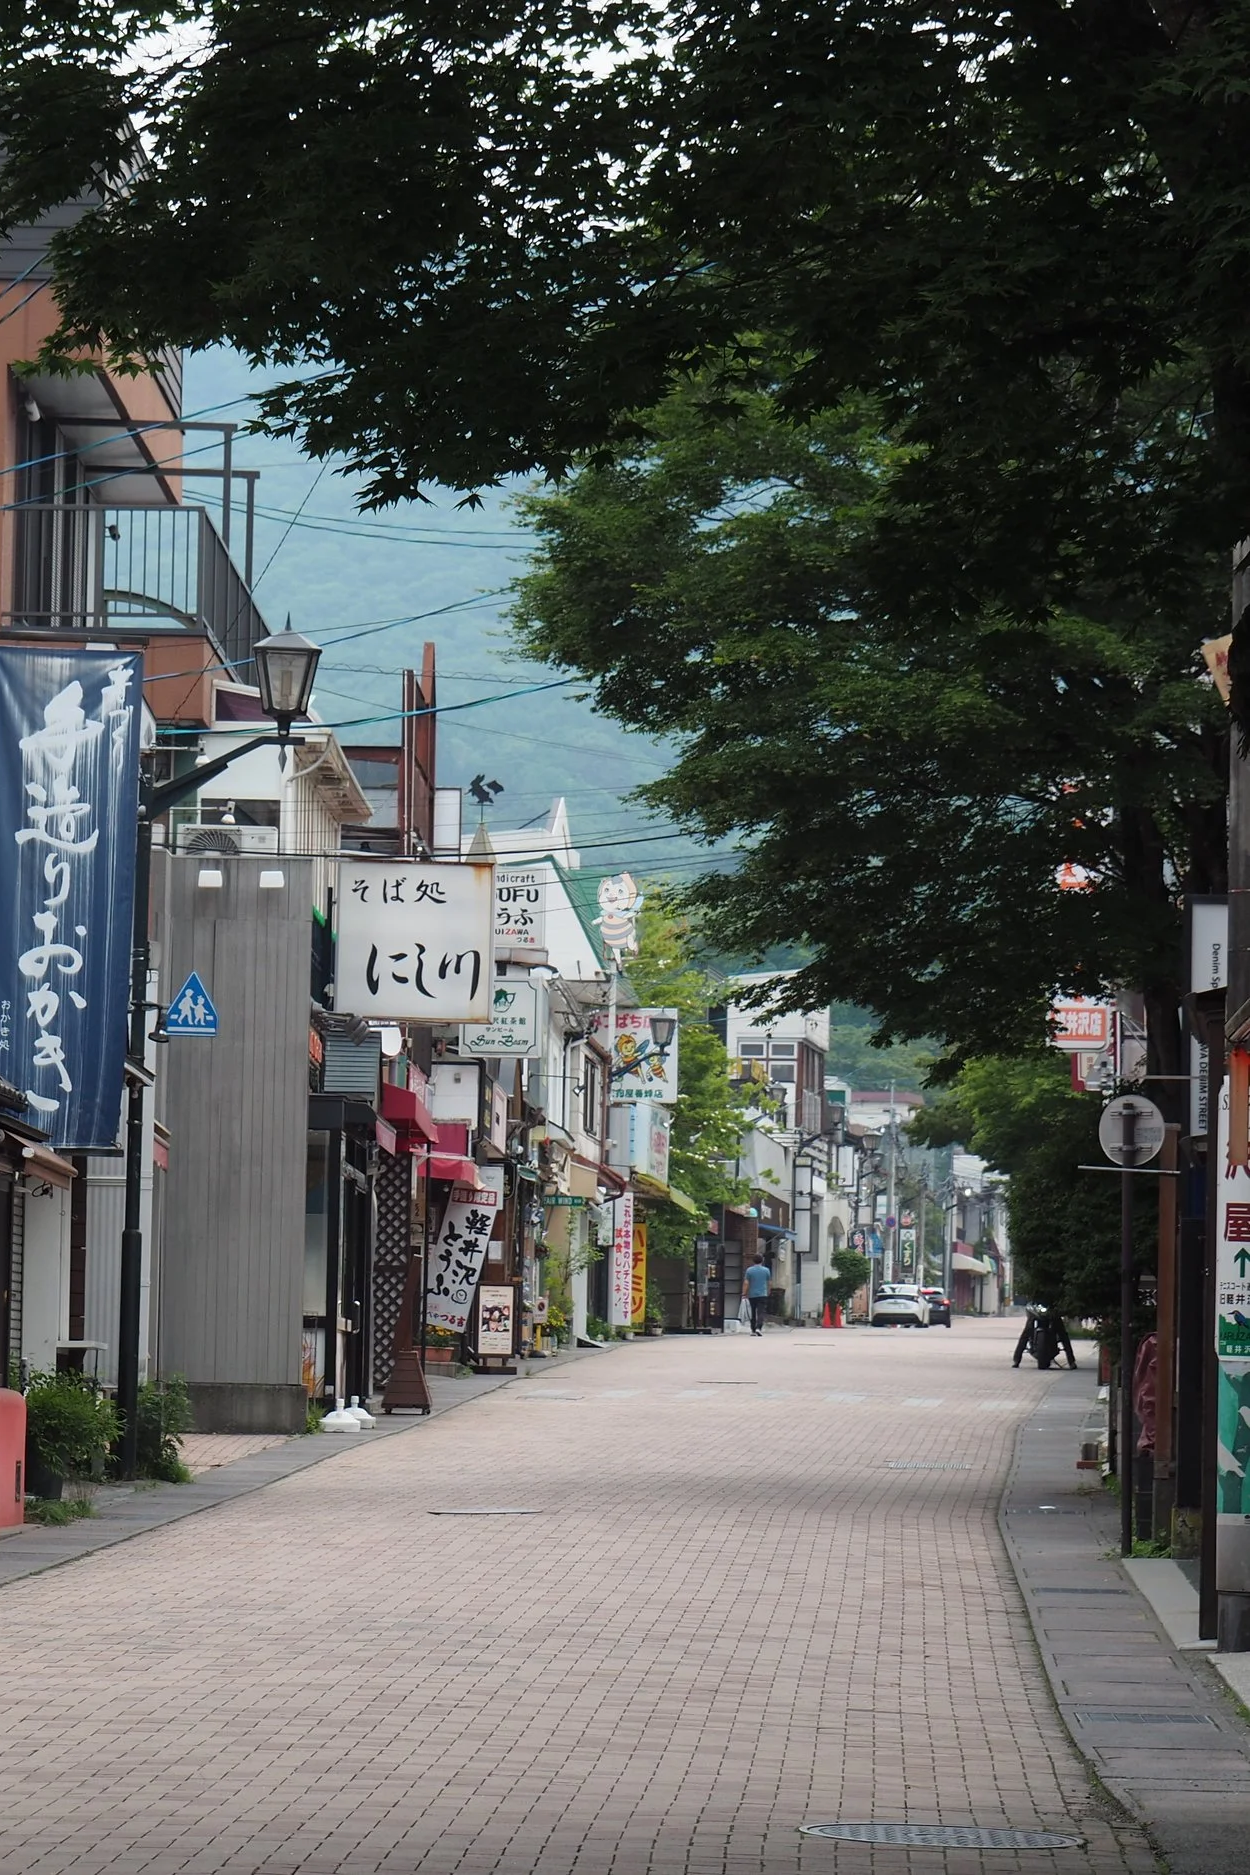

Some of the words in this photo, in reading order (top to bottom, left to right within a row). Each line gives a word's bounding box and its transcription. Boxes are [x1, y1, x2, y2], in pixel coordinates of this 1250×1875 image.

[351, 877, 448, 904] そば処
[366, 943, 482, 1001] にし川
[1211, 943, 1221, 973] Denim
[470, 1034, 496, 1046] Sun
[1198, 1095, 1208, 1130] STREET
